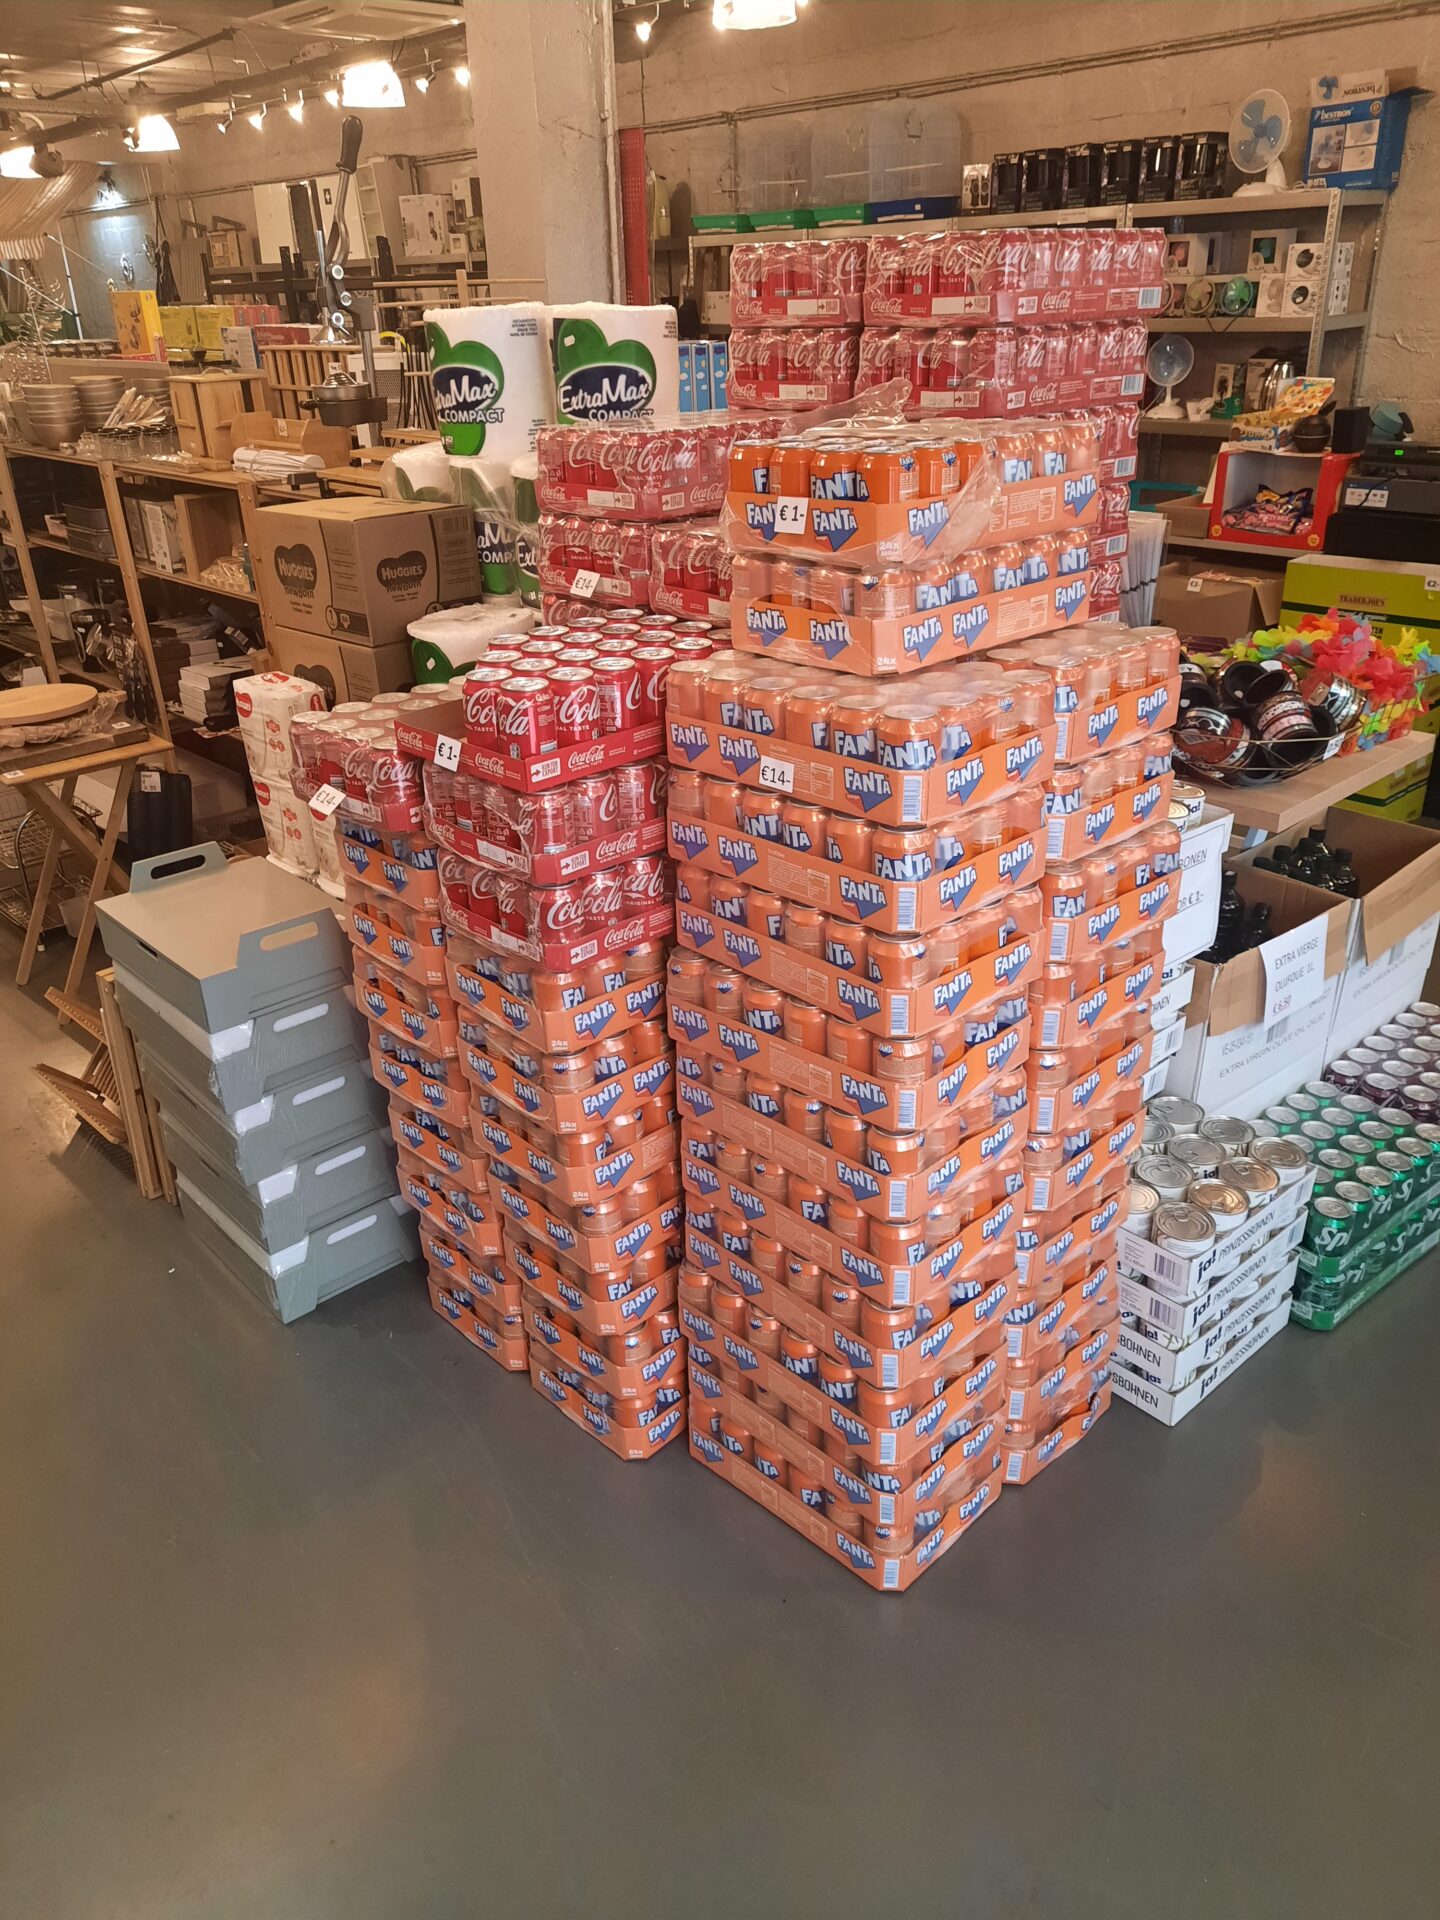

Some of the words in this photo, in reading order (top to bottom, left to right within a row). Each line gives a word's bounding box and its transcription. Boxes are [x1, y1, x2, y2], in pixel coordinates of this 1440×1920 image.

[560, 374, 651, 413] ExtraMax
[445, 409, 504, 424] COMPACT
[1064, 474, 1097, 503] FANTA
[812, 507, 858, 532] FANTA
[278, 558, 313, 581] HUGGIES
[381, 565, 422, 580] HUGGIES
[575, 576, 594, 592] €14-
[1055, 580, 1087, 608] FANTA
[747, 608, 787, 630] FANTA
[902, 615, 943, 650] FANTA
[952, 603, 989, 637] FANTA
[670, 723, 709, 746] FANTA
[718, 735, 760, 760] FANTA
[761, 766, 790, 786] €14-
[843, 767, 892, 795] FANTA
[316, 791, 336, 806] €14-
[671, 822, 708, 845] FANTA
[718, 836, 758, 861] FANTA
[874, 851, 932, 881] FANTA
[840, 877, 887, 905] FANTA
[939, 866, 977, 899] FANTA
[680, 911, 715, 936] FANTA
[994, 944, 1031, 977] FANTA
[837, 978, 881, 1010] FANTA
[934, 971, 973, 1005] FANTA
[672, 1005, 709, 1031] FANTA
[718, 1024, 760, 1050] FANTA
[680, 1082, 714, 1108] FANTA
[938, 1063, 968, 1099] FANTA
[981, 1120, 1015, 1156] FANTA
[729, 1184, 765, 1215] FANTA
[983, 1203, 1014, 1238] FANTA
[689, 1234, 720, 1263] FANTA
[931, 1240, 964, 1277] FANTA
[729, 1259, 763, 1290] FANTA
[841, 1248, 884, 1282] FANTA
[975, 1284, 1007, 1319] FANTA
[683, 1308, 715, 1337] FANTA
[724, 1336, 759, 1366] FANTA
[1117, 1334, 1161, 1367] BOHNEN
[691, 1366, 722, 1394] FANTA
[965, 1360, 997, 1394] FANTA
[1112, 1372, 1159, 1409] SBOHNEN
[830, 1407, 871, 1443] FANTA
[963, 1423, 994, 1456] FANTA
[692, 1431, 723, 1460] FANTA
[833, 1466, 871, 1503] FANTA
[916, 1463, 946, 1501] FANTA
